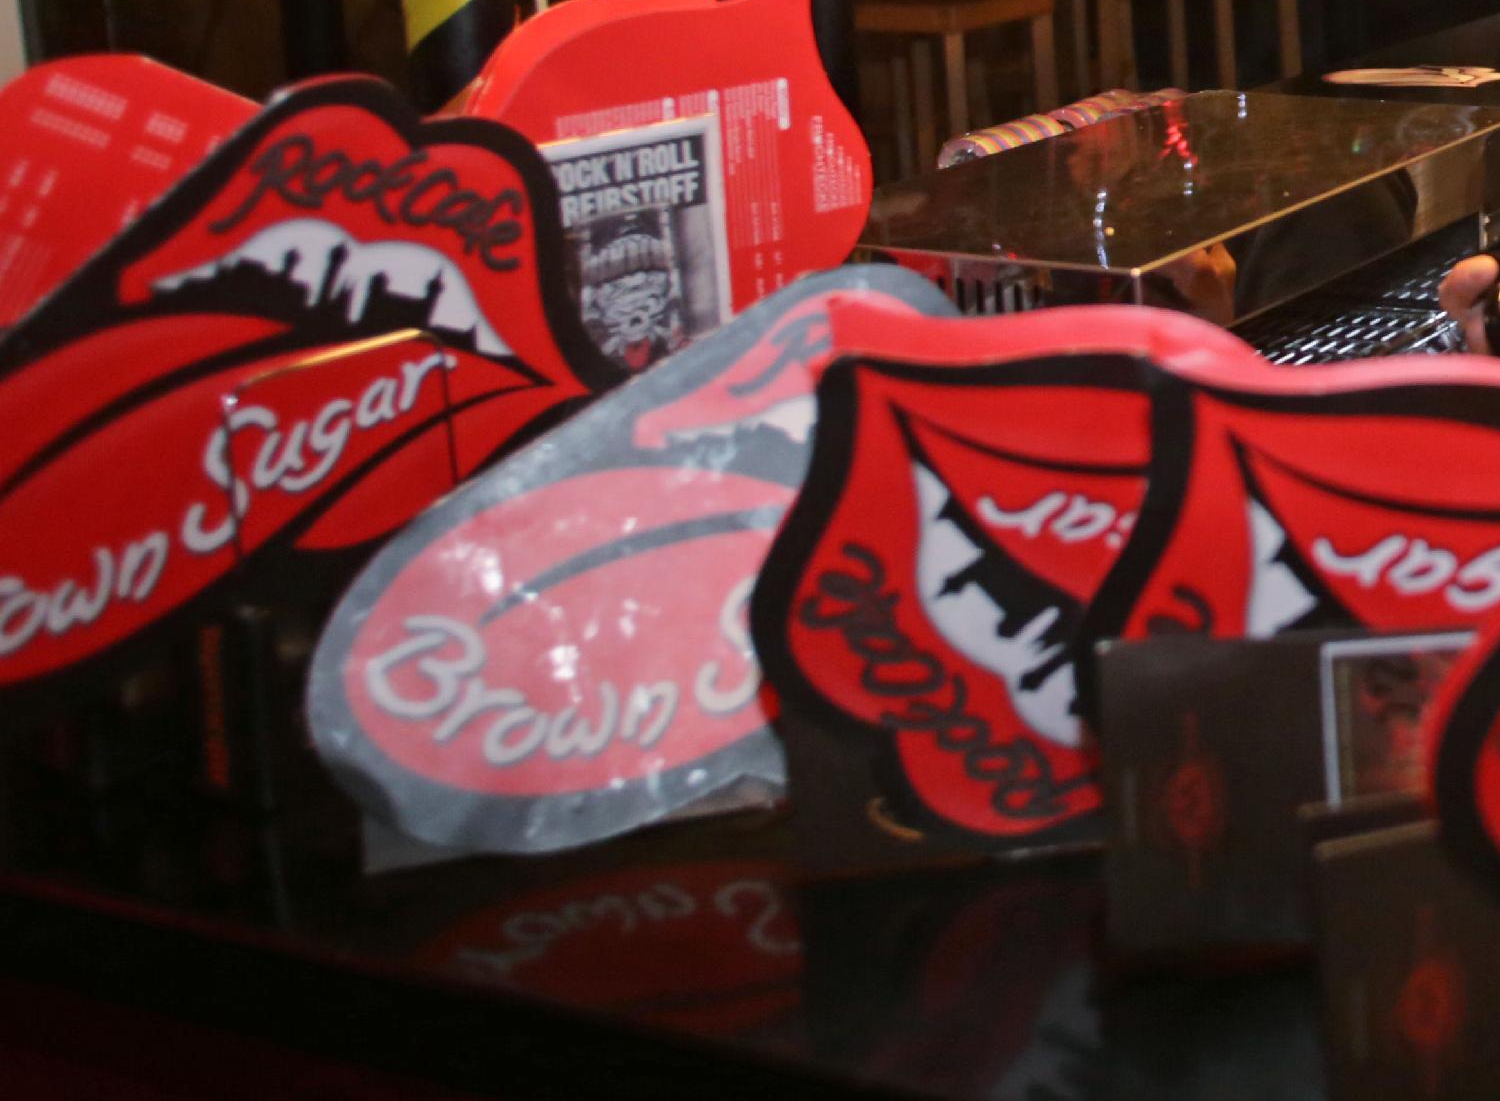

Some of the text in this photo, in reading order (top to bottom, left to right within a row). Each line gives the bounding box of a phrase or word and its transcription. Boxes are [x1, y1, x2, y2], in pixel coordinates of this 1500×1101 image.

[552, 140, 699, 193] OCK'N'ROLL
[0, 350, 457, 657] own Sugar
[978, 489, 1137, 551] ar
[366, 614, 680, 767] Brown
